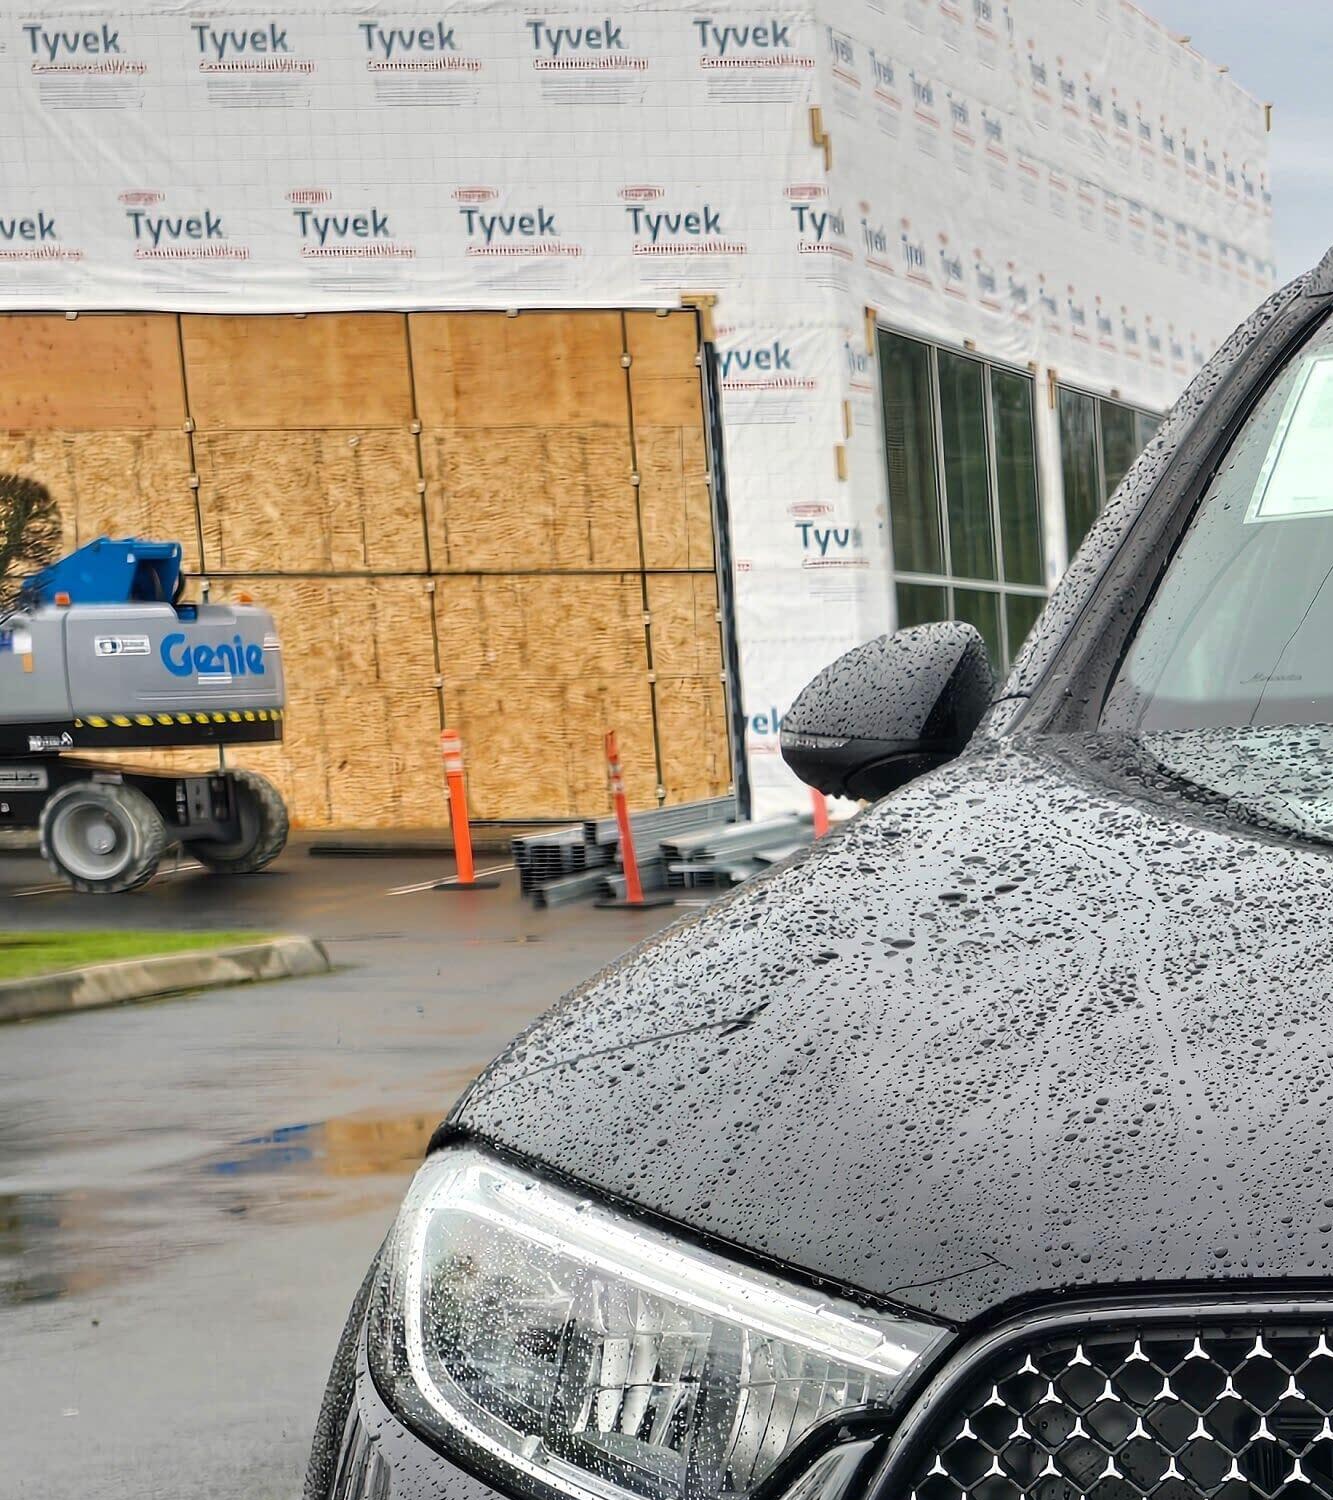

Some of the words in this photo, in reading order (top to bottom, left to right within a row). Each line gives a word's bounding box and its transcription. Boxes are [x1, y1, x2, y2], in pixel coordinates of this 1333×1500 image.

[23, 23, 121, 61] Tyvek
[190, 22, 289, 60] Tyvek
[358, 21, 456, 59] Tyvek
[526, 19, 624, 55] Tyvek
[693, 19, 790, 55] Tyvek
[0, 211, 56, 240] vek
[126, 208, 224, 248] Tyvek
[293, 206, 389, 246] Tyvek
[459, 205, 555, 244] Tyvek
[625, 204, 721, 243] Tyvek
[718, 341, 791, 378] yvek
[795, 521, 862, 556] Tyv
[160, 632, 265, 677] Genie
